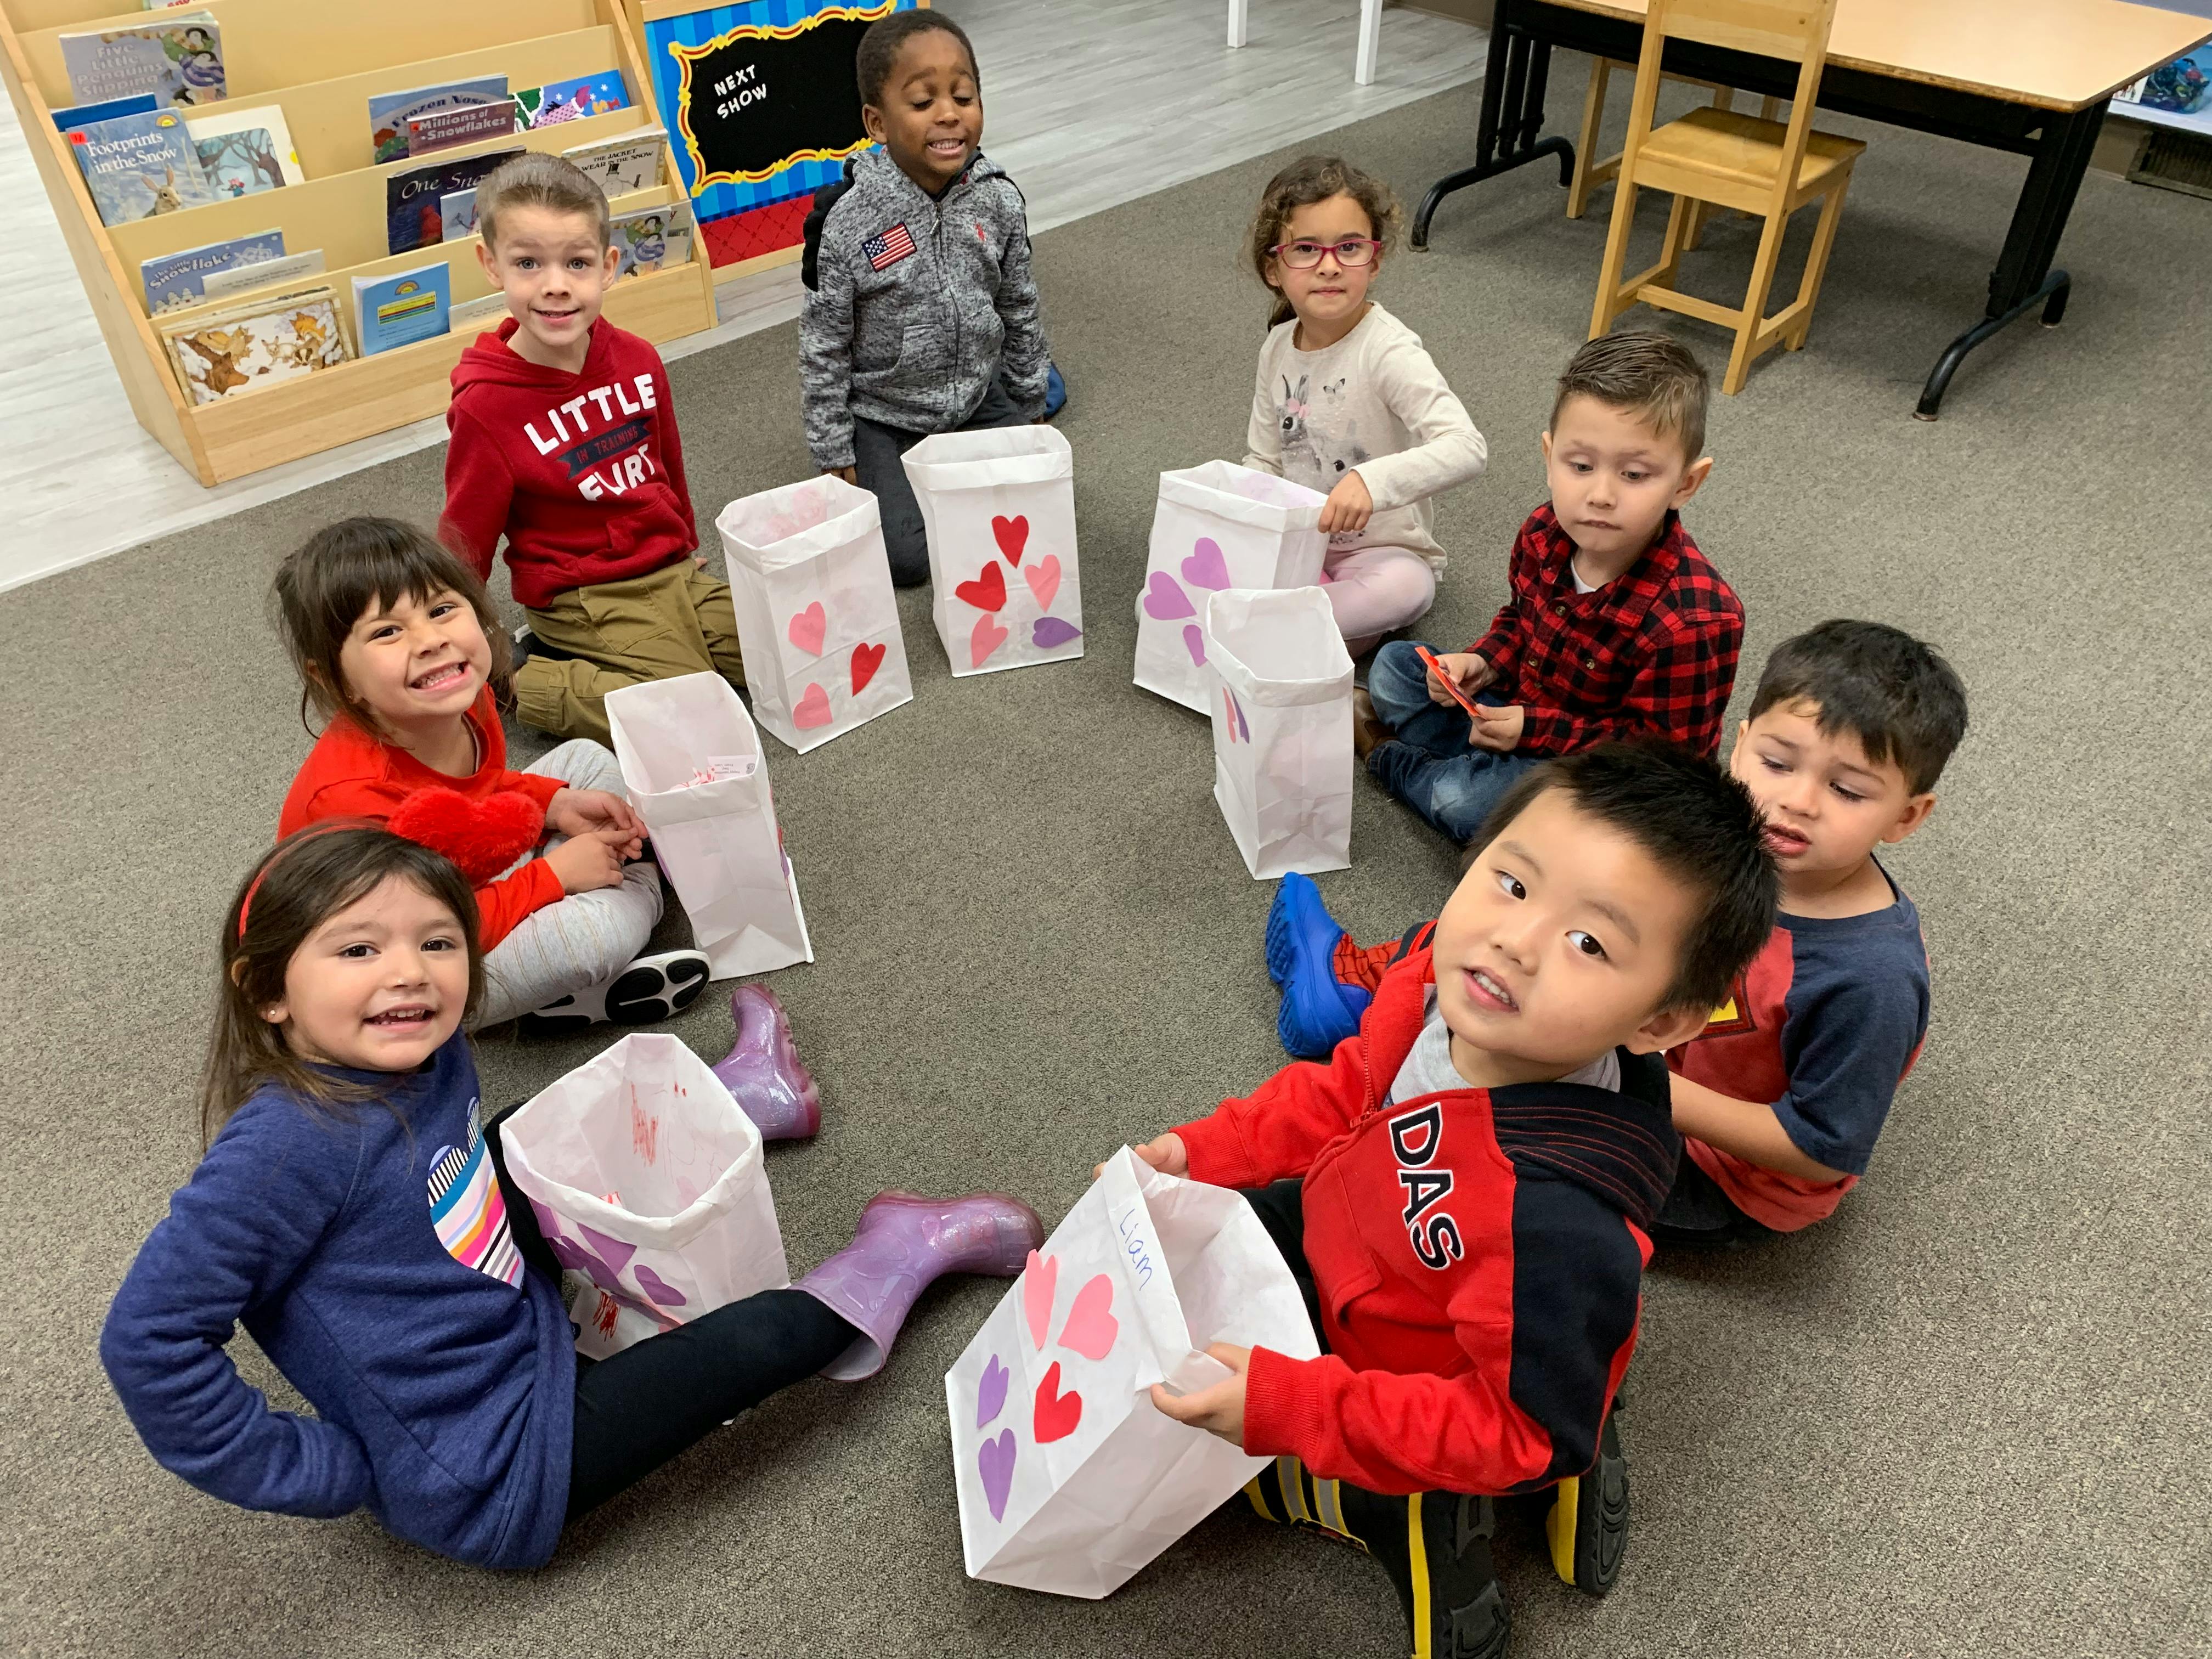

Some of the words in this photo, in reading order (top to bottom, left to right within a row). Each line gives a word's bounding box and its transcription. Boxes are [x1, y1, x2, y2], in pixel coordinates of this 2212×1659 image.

[97, 44, 134, 58] Five
[77, 63, 163, 84] Penguins
[92, 55, 138, 71] Little
[82, 75, 158, 95] Slipping
[714, 64, 755, 96] NEXT
[717, 83, 766, 119] SHOW
[419, 112, 476, 131] Millions
[478, 109, 488, 117] of
[427, 117, 506, 140] Snowflakes
[86, 132, 163, 156] Footprints
[608, 148, 637, 159] JACKET
[94, 160, 112, 173] in
[111, 154, 137, 170] the
[136, 148, 176, 164] Snow
[582, 162, 607, 171] WEAR
[631, 151, 653, 160] SNOW
[402, 179, 439, 199] One
[149, 252, 232, 289] Snowflake
[523, 373, 657, 455] LITTLE
[1388, 1102, 1464, 1271] DAS
[1120, 1208, 1152, 1291] Liam
